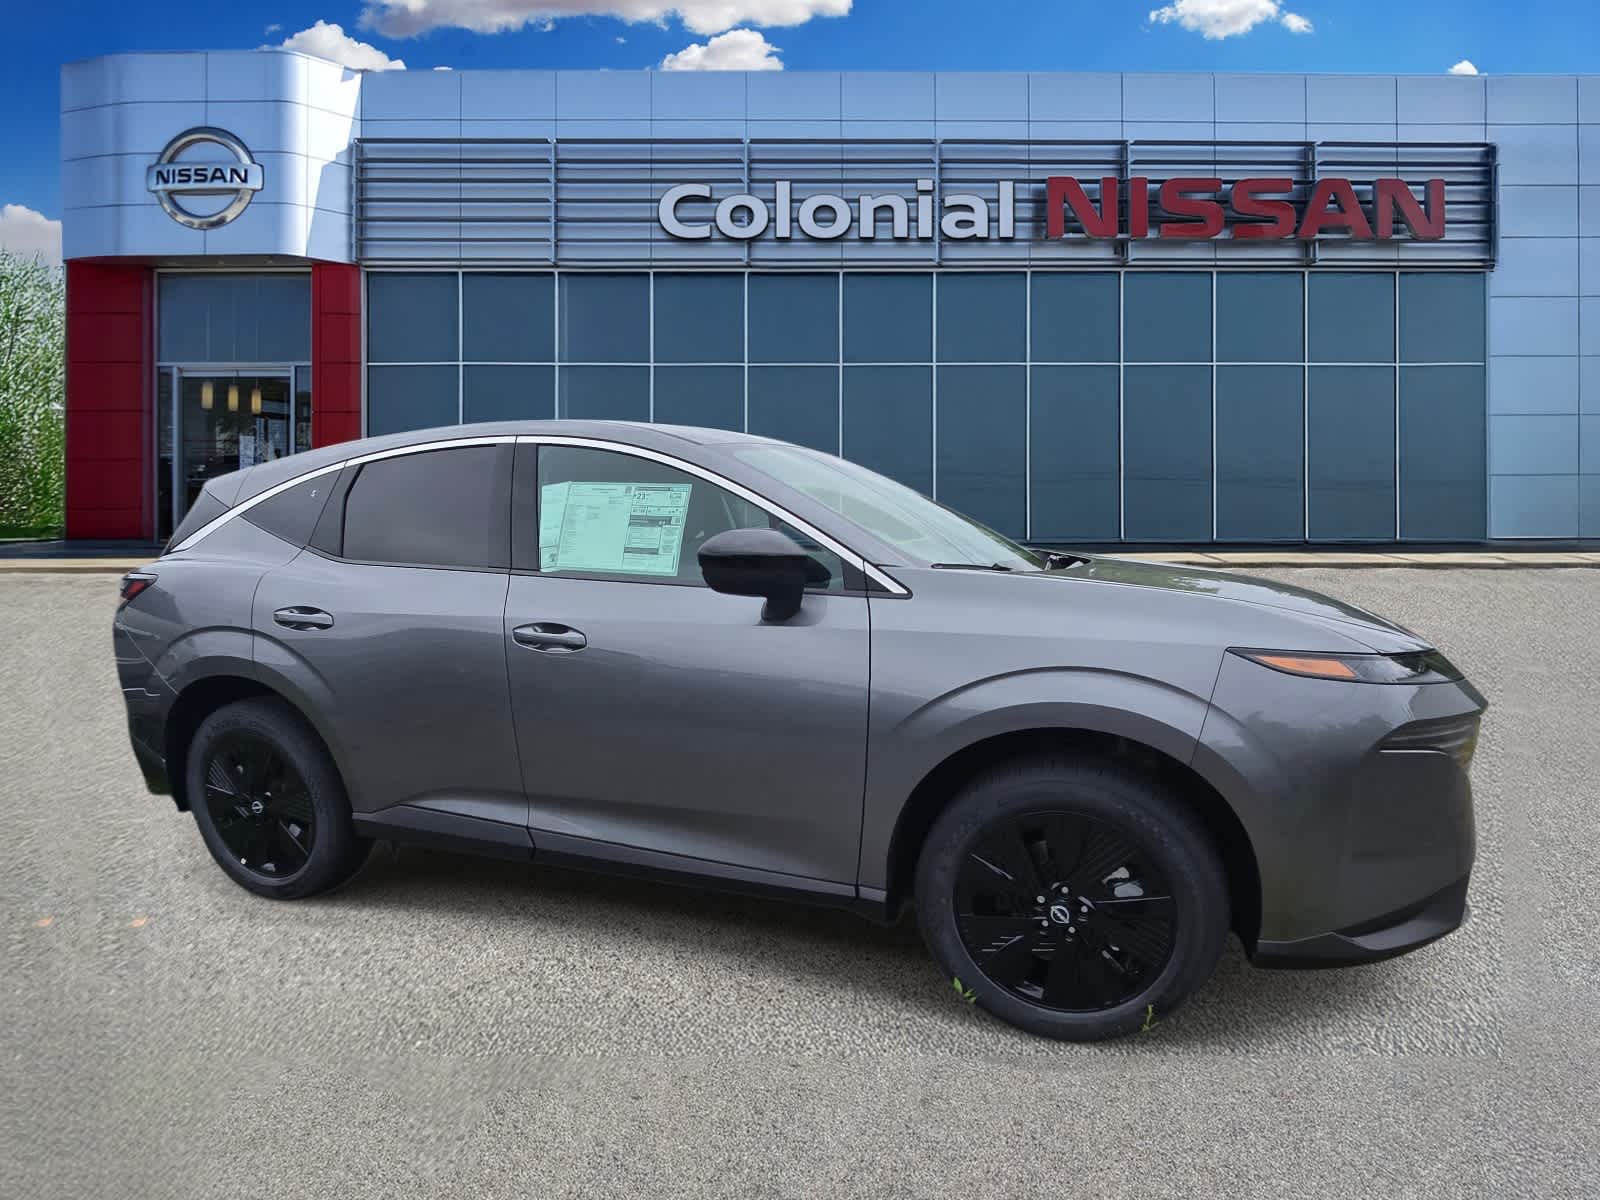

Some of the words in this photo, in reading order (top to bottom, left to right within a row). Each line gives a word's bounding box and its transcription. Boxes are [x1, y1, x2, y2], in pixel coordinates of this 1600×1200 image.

[156, 168, 247, 185] NISSAN
[658, 179, 1014, 241] Colonial
[1047, 176, 1446, 240] NISSAN
